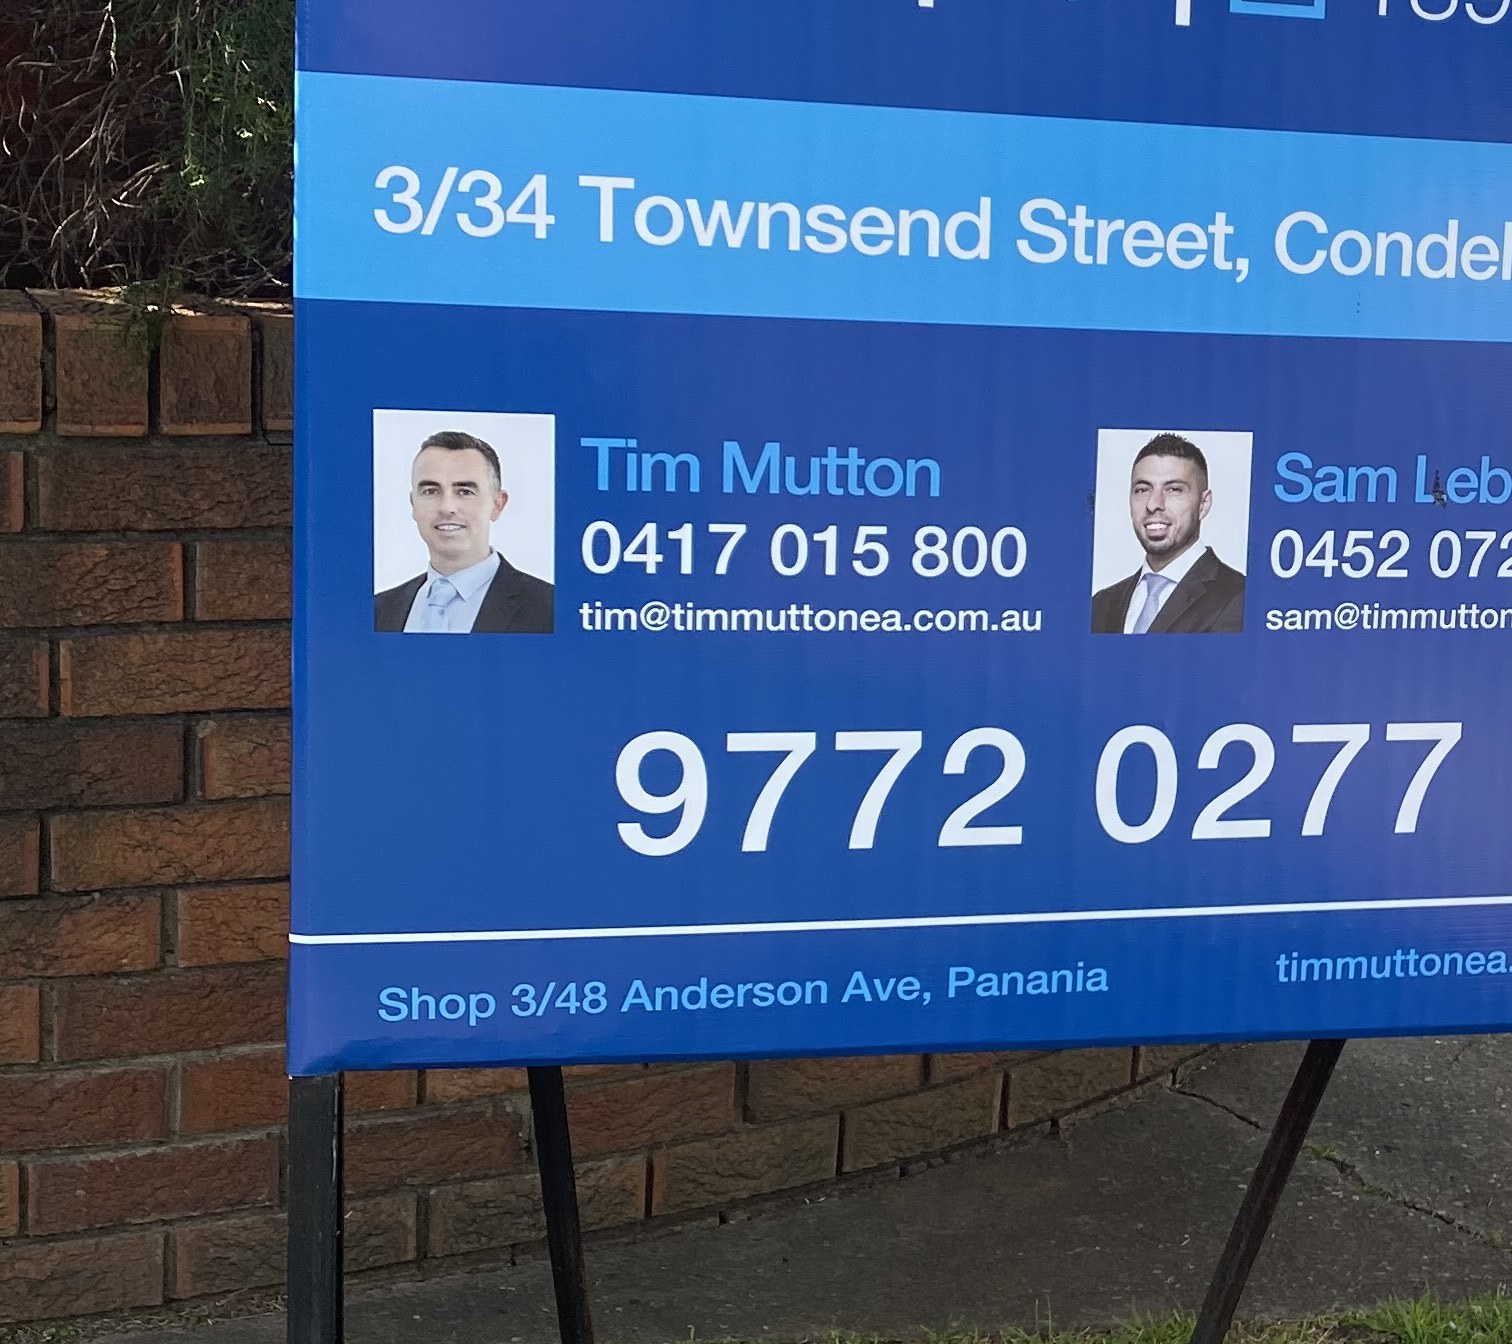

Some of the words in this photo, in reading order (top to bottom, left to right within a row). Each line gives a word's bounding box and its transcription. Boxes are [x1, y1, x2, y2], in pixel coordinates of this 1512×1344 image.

[374, 165, 555, 239] 3/34
[578, 175, 991, 260] Townsend
[1016, 198, 1249, 283] Street,
[580, 437, 700, 493] Tim
[722, 440, 941, 498] Mutton
[1274, 452, 1397, 504] Sam
[581, 520, 747, 575] 0417
[770, 523, 890, 577] 015
[911, 525, 1028, 578] 800
[1270, 528, 1411, 579] 0452
[578, 600, 1043, 633] tim@timmuttonea.com.au
[615, 726, 1027, 857] 9772
[1095, 721, 1464, 844] 0277
[378, 986, 496, 1027] Shop
[511, 981, 608, 1018] 3/48
[620, 974, 828, 1013] Anderson
[840, 970, 933, 1007] Ave,
[947, 960, 1110, 999] Panania
